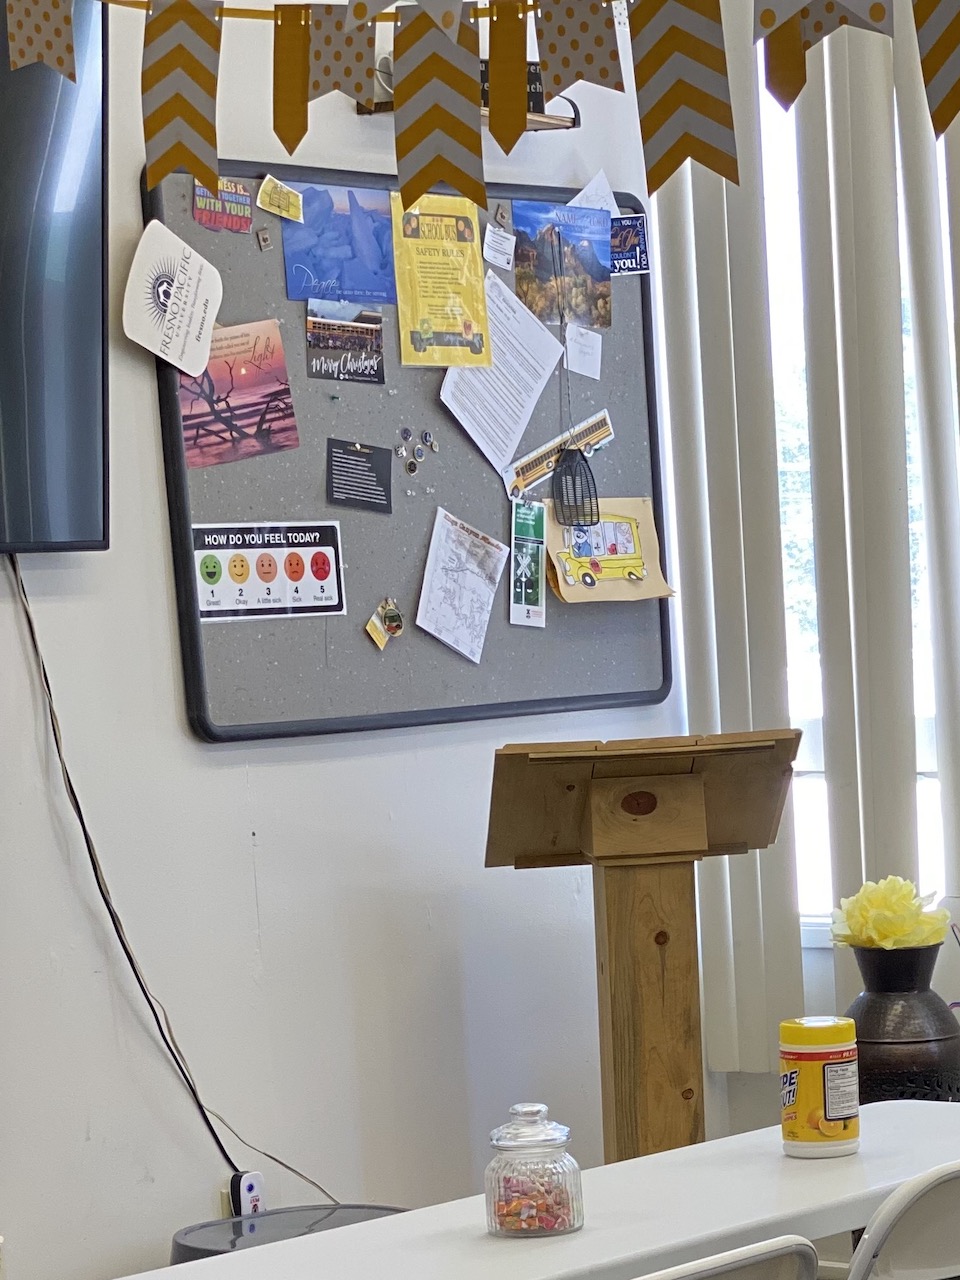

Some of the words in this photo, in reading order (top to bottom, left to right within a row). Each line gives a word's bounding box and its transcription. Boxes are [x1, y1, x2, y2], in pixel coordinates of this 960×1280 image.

[196, 197, 222, 212] WITH
[224, 201, 252, 218] YOUR
[421, 222, 445, 240] SCHOOL
[416, 246, 440, 257] SAFETY
[442, 248, 465, 258] RULES
[640, 253, 648, 268] YOU
[292, 263, 340, 296] Peace
[160, 302, 180, 356] FRESNO
[174, 247, 192, 302] PACIFIC
[175, 276, 193, 338] UNIVERSITY
[195, 298, 209, 342] fresno.edu
[311, 356, 340, 378] Merry
[340, 352, 382, 373] Christmas
[204, 534, 227, 546] HOW
[229, 534, 243, 545] DO
[243, 533, 263, 544] YOU
[264, 533, 286, 544] FEEL
[287, 532, 320, 544] TODAY?
[210, 589, 215, 598] 1
[238, 588, 244, 597] 2
[266, 587, 271, 596] 3
[294, 586, 299, 595] 4
[320, 585, 325, 594] 5
[235, 598, 248, 607] Okay
